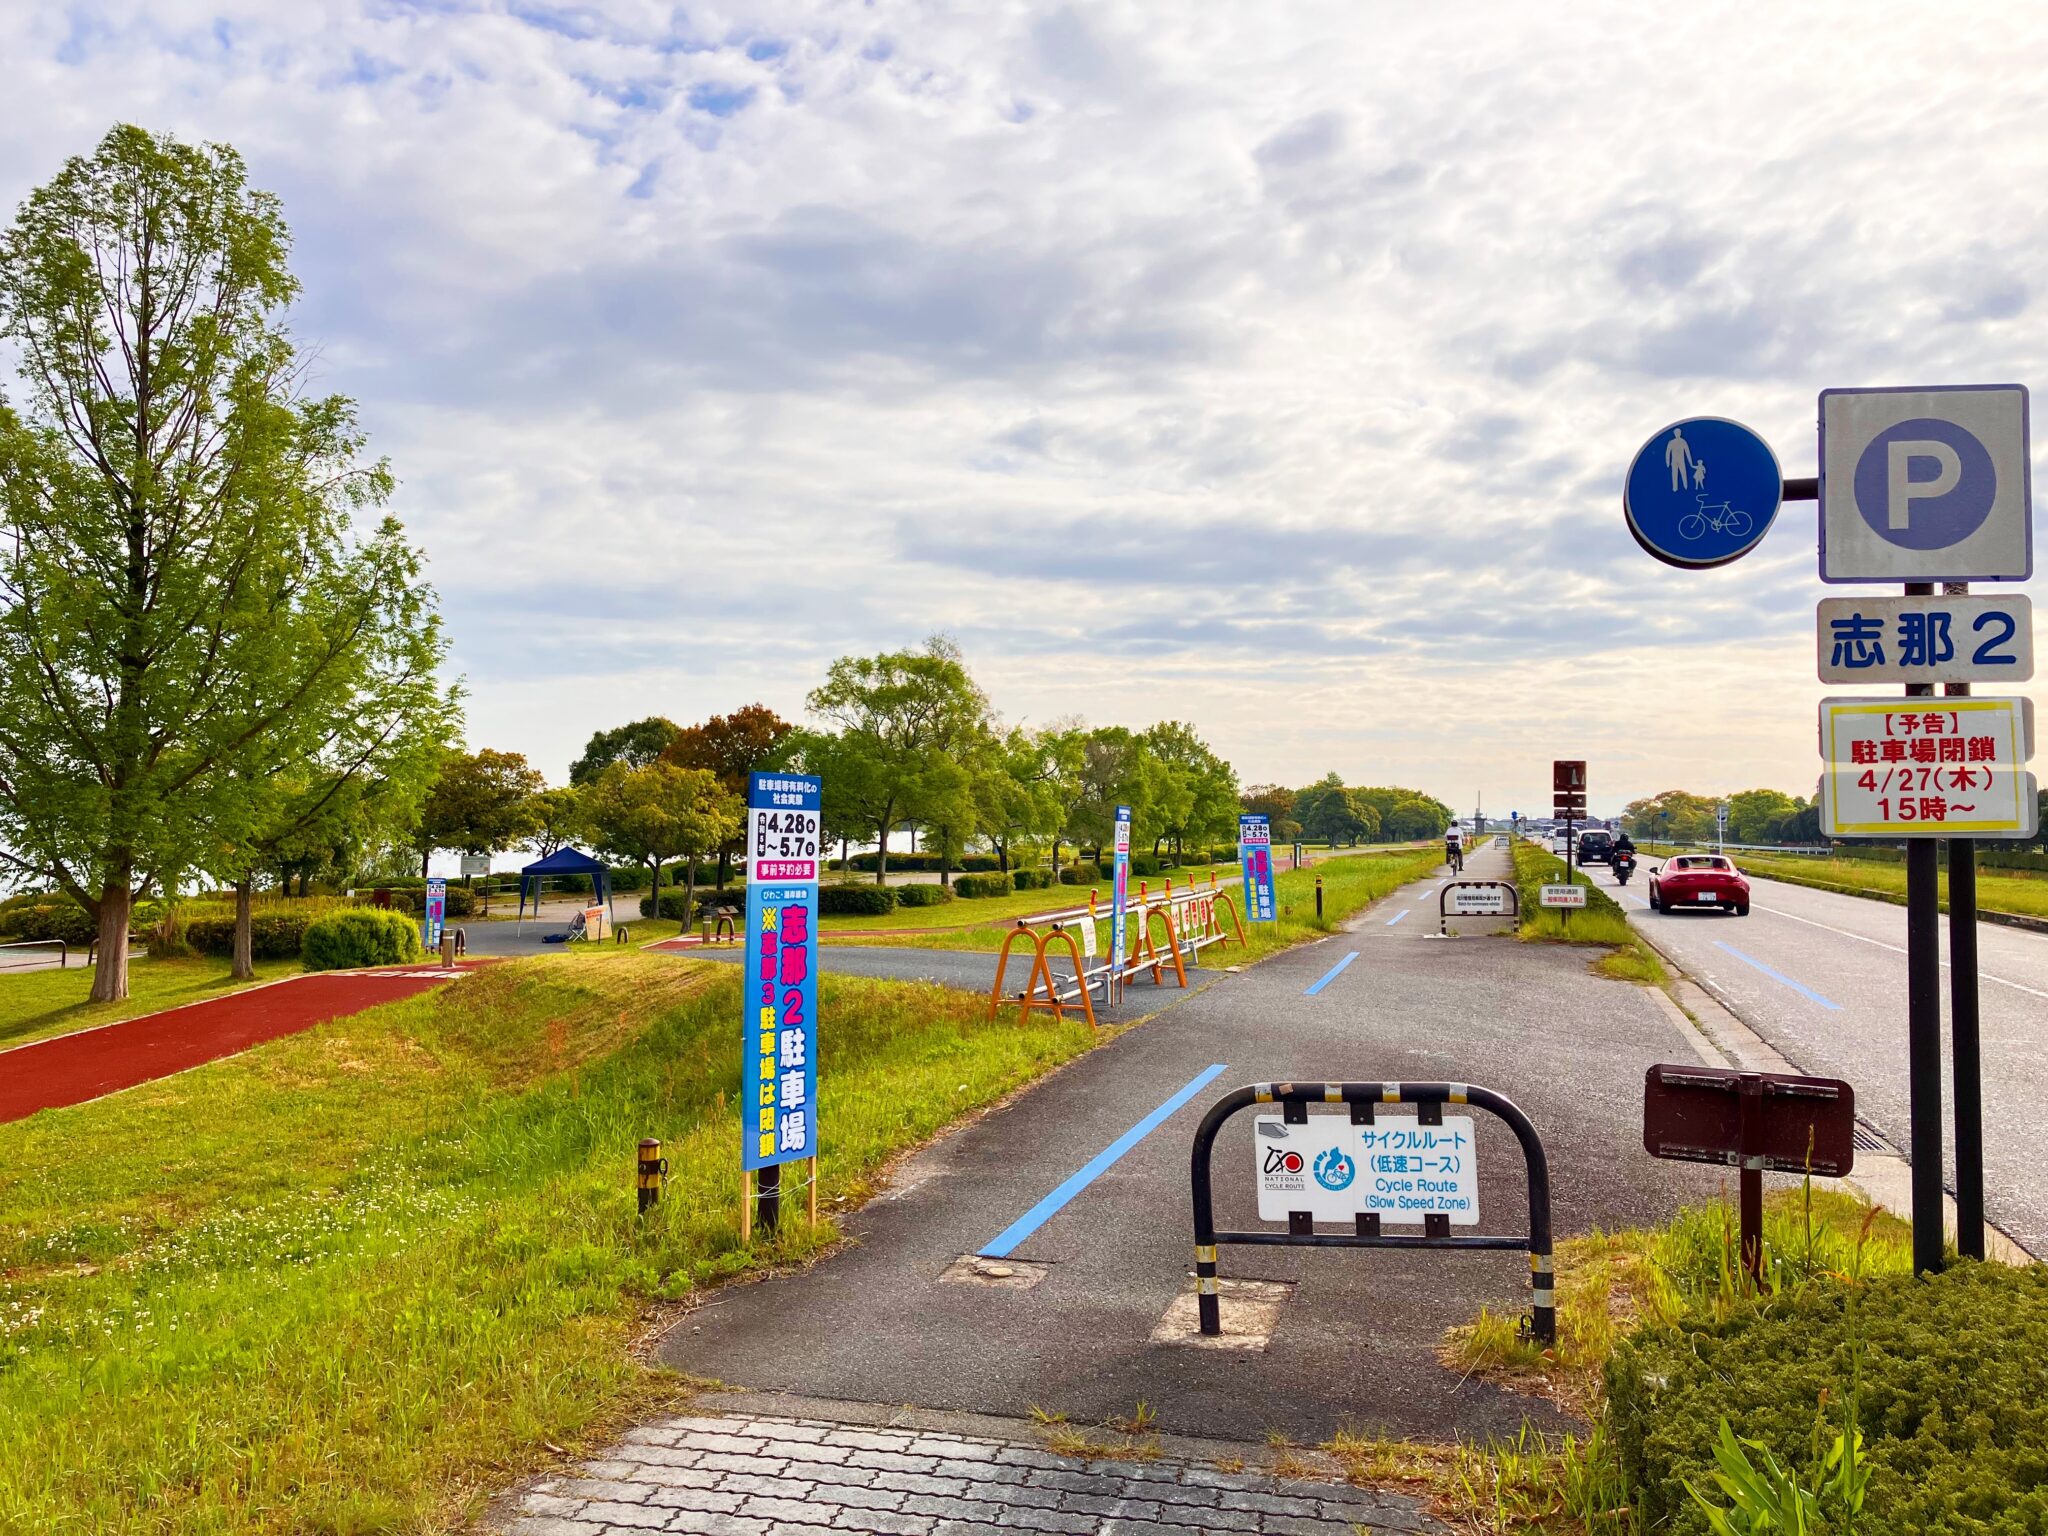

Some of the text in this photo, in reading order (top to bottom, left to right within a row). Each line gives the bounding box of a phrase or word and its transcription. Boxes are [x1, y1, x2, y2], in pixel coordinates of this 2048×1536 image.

[1888, 440, 1961, 530] P
[1830, 610, 2017, 669] 志那2
[1851, 736, 1997, 764] 駐車場閉鎖
[760, 863, 812, 877] 事前予約必要
[780, 904, 808, 1152] 志那2駐車場
[1361, 1131, 1467, 1150] サイクルルート
[1370, 1155, 1461, 1174] (低速コース)
[1375, 1178, 1458, 1194] Cycle Route
[1364, 1195, 1471, 1211] (Slow Speed Zone)
